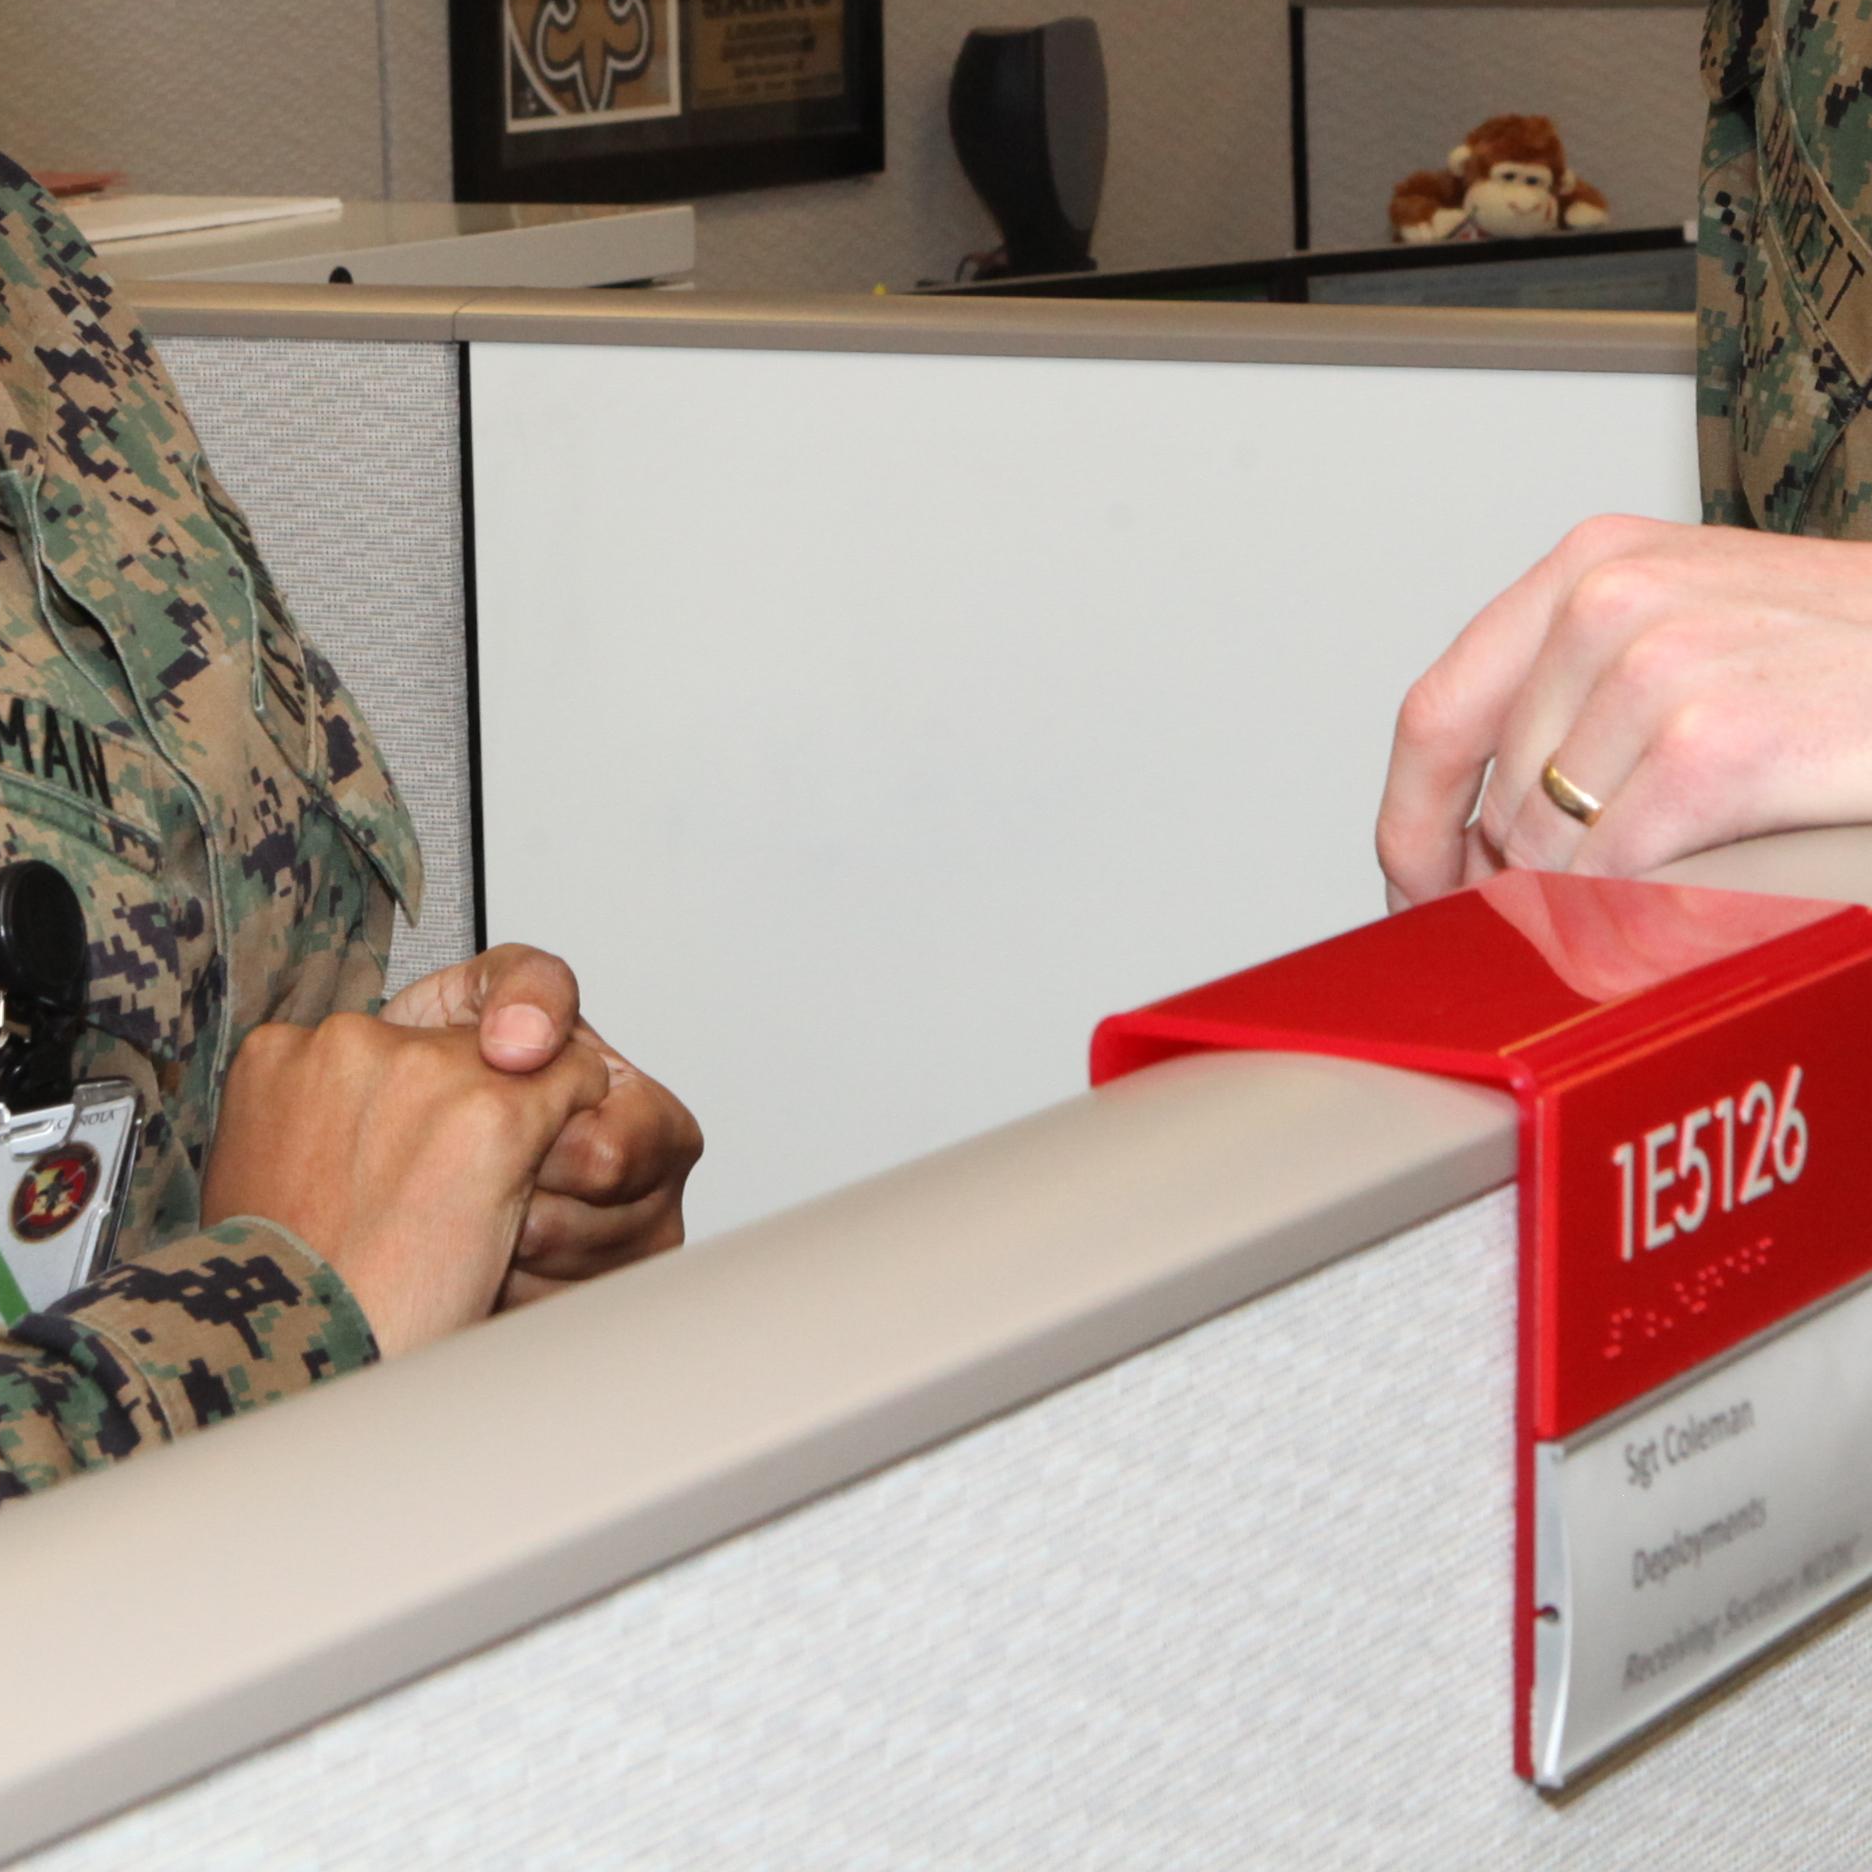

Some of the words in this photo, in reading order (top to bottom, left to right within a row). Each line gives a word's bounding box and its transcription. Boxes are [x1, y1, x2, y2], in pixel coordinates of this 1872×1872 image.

[1612, 1064, 1809, 1262] 1E5126
[1624, 1439, 1660, 1490] Sgt
[1663, 1399, 1755, 1467] Coleman
